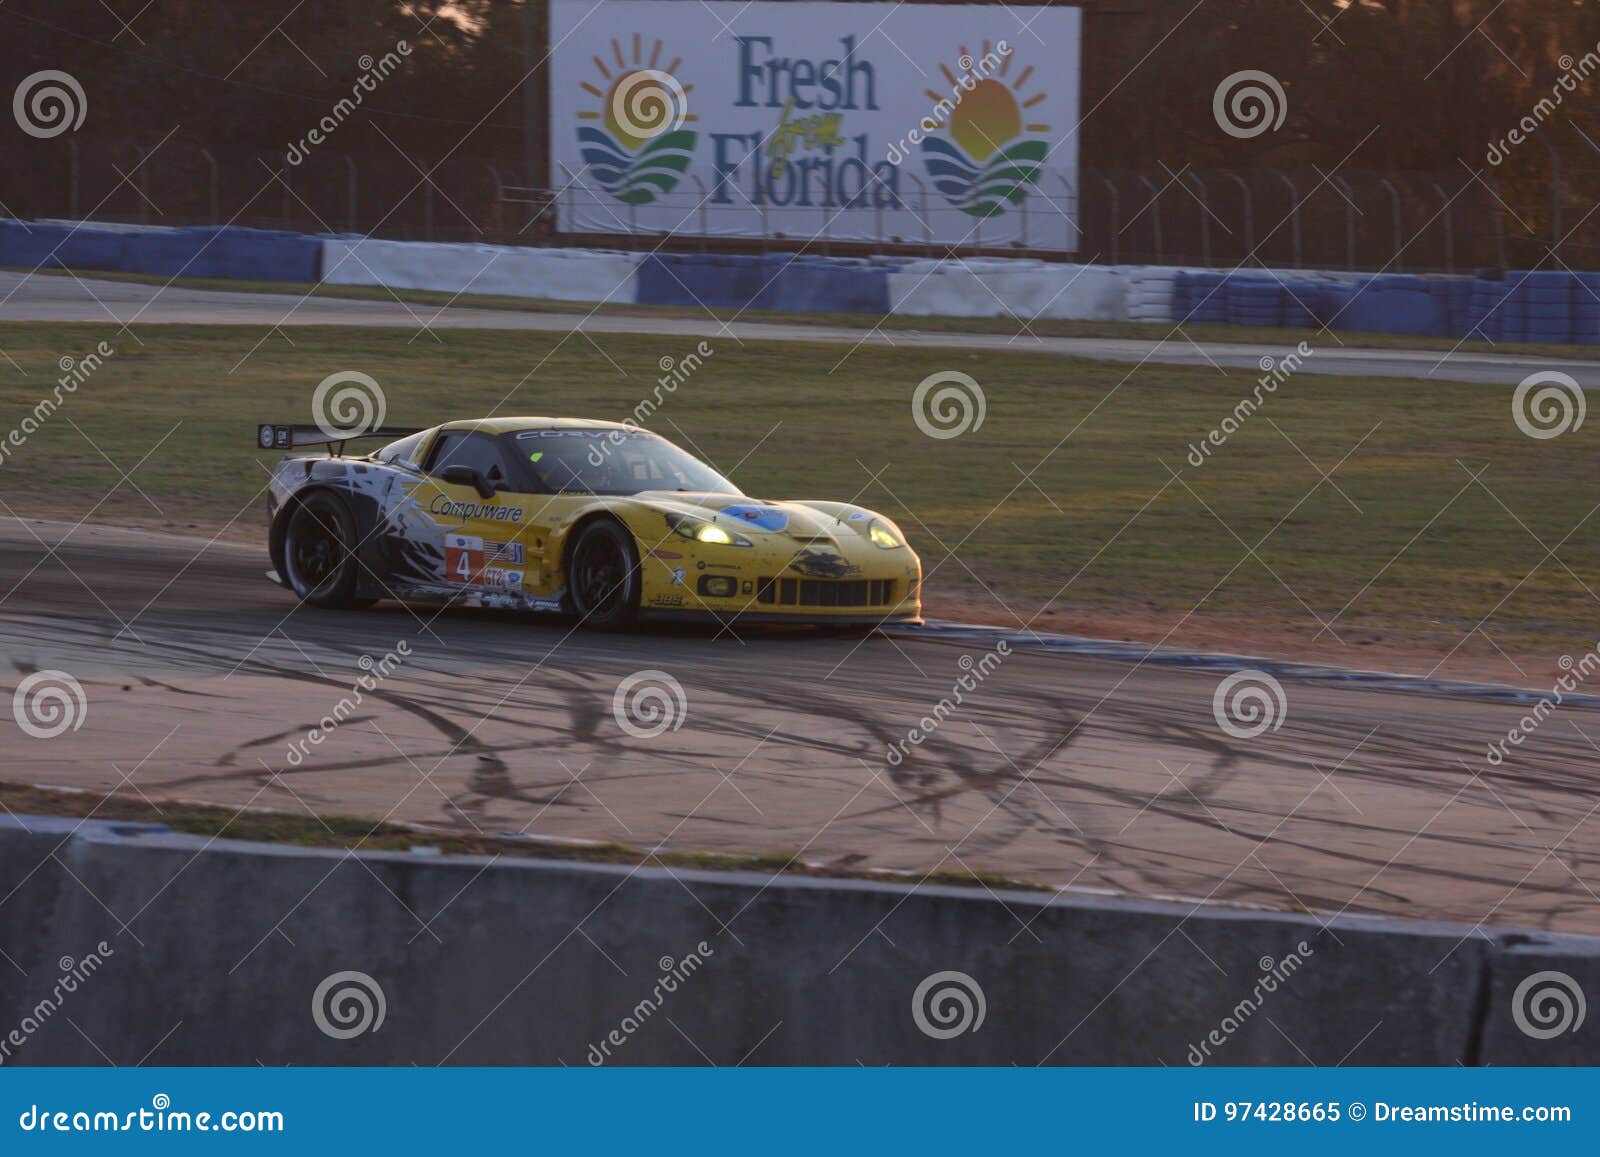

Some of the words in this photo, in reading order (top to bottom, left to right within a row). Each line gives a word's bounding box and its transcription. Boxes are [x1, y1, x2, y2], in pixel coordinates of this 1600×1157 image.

[734, 34, 879, 111] Fresh
[709, 131, 903, 210] Florida
[430, 493, 523, 523] Compuware
[456, 551, 471, 581] 4
